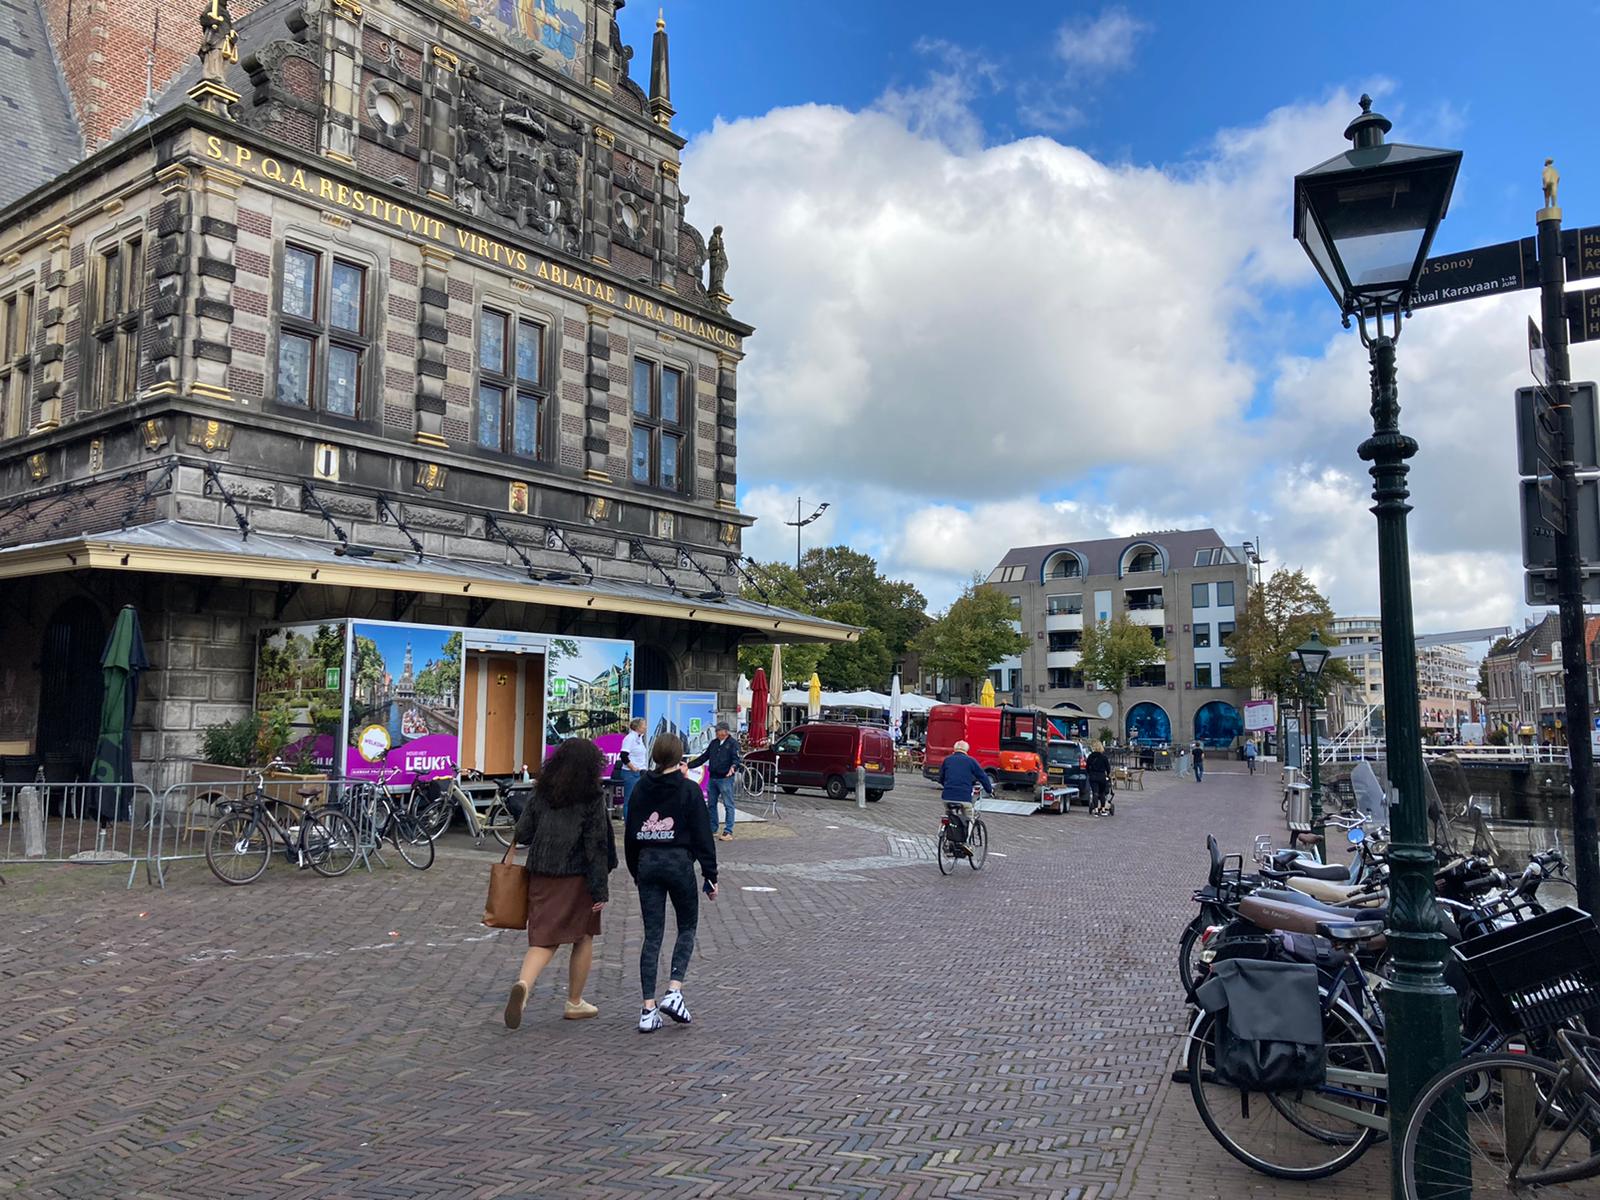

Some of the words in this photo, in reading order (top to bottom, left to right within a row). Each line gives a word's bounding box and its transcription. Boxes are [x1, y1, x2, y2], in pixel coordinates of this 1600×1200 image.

[319, 176, 446, 241] RESTITVIT
[456, 228, 527, 271] VIRTVS
[537, 261, 615, 304] ABLATAE
[624, 294, 666, 323] JVRA
[672, 311, 736, 348] BILANCIS
[1434, 257, 1474, 273] Sonoy
[1442, 280, 1499, 299] Karavaan
[636, 830, 675, 840] SNEAKERZ
